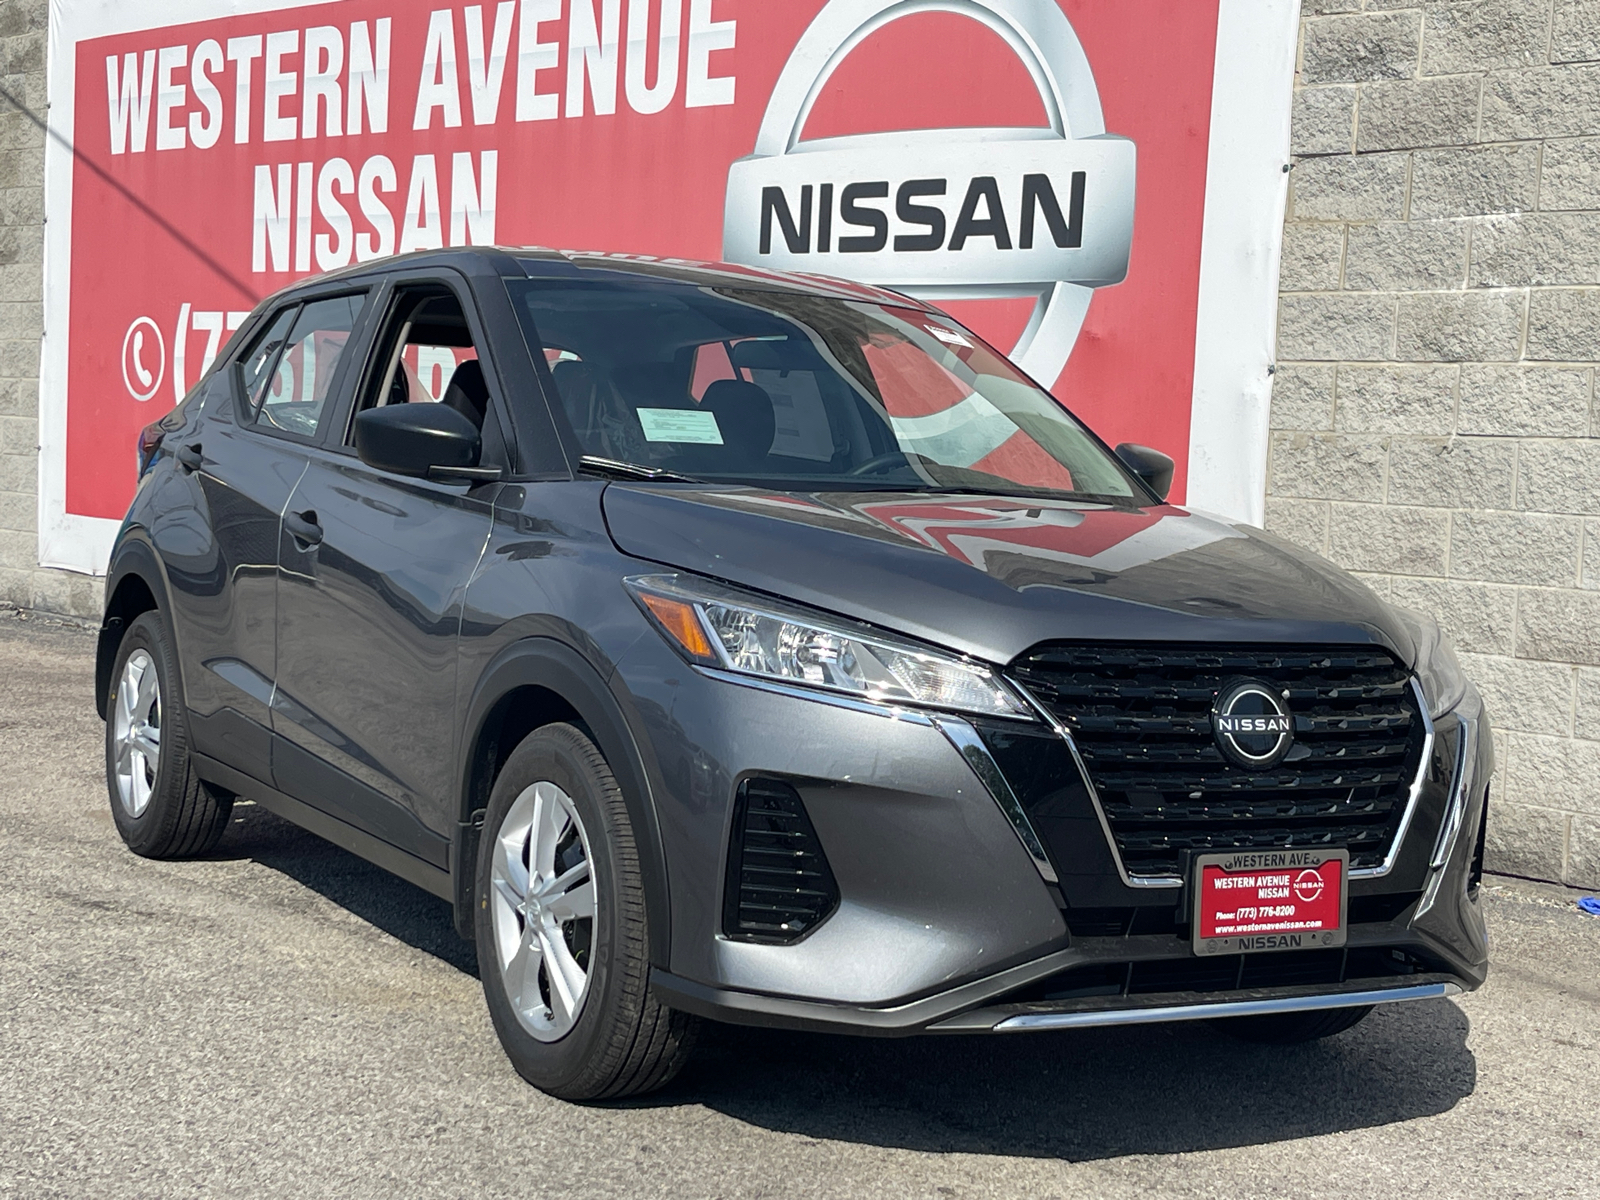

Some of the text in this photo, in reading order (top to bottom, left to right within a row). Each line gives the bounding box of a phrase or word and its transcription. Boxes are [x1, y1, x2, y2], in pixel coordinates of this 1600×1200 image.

[106, 0, 737, 155] WESTERN AVENUE
[252, 150, 498, 273] NISSAN
[759, 171, 1087, 255] NISSAN
[1218, 718, 1290, 731] NISSAN
[1233, 853, 1286, 868] WESTERN
[1214, 875, 1291, 889] WESTERN AVENUE
[1258, 887, 1290, 899] NISSAN
[1236, 906, 1257, 921] (773)
[1259, 905, 1296, 917] 776-8200
[1215, 920, 1322, 934] www.westernavenissan.com
[1238, 934, 1302, 950] NISSAN
